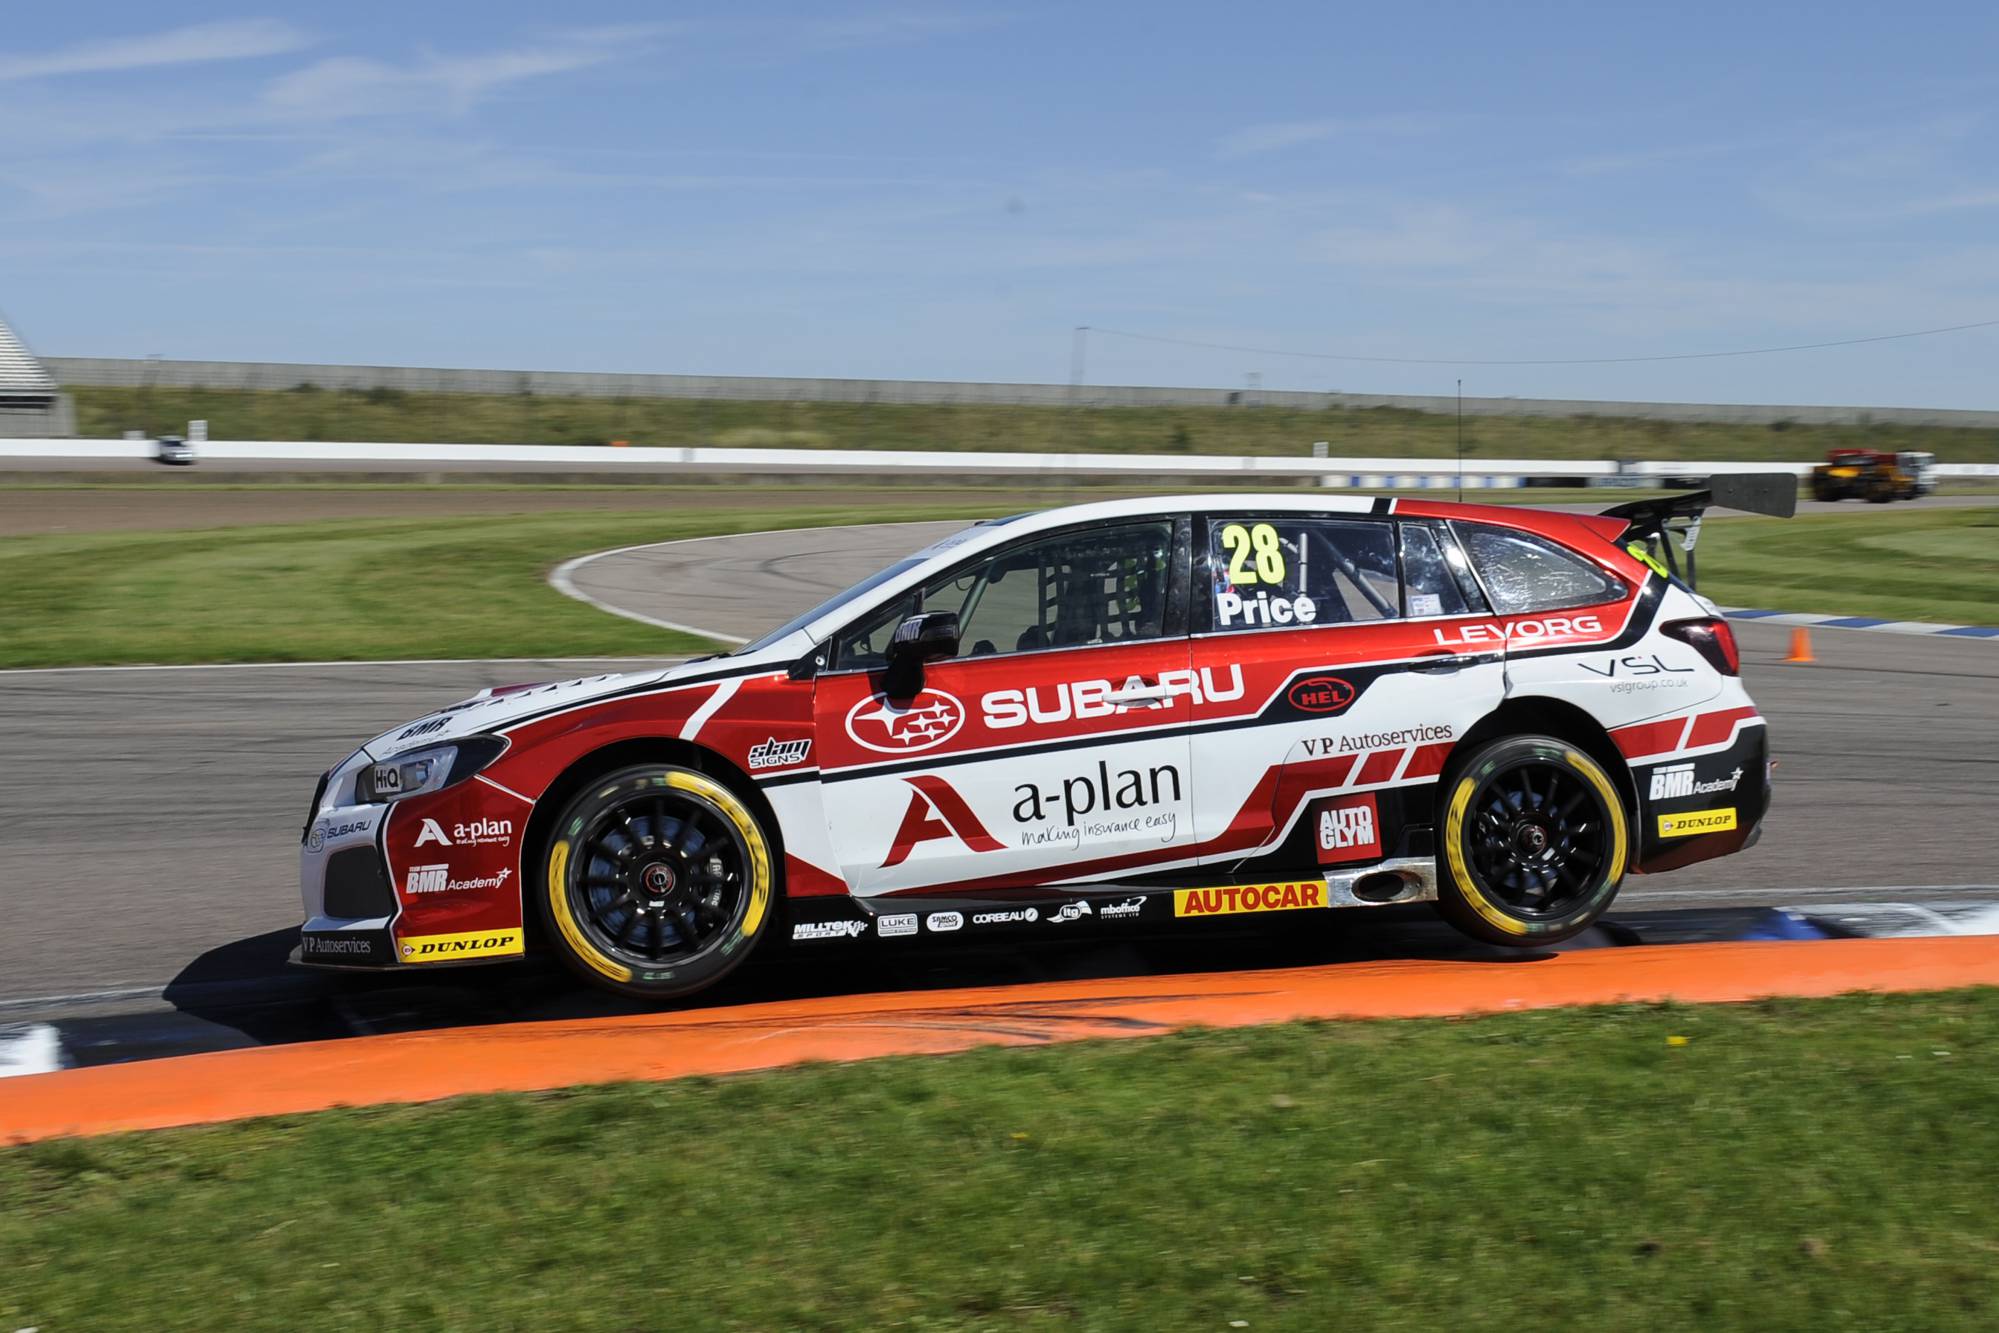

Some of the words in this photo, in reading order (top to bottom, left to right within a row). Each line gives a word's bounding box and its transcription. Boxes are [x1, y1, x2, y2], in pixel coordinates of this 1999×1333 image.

[1222, 523, 1285, 584] 28
[1216, 591, 1317, 626] Price
[1434, 615, 1602, 645] LEVORG
[1577, 655, 1694, 677] VSL
[981, 664, 1245, 729] SUBARU
[1301, 690, 1345, 706] HEL
[1339, 723, 1453, 752] Autoservices
[750, 754, 801, 767] SIGNS
[376, 768, 399, 789] HiQ
[1649, 770, 1695, 800] BMR
[1012, 760, 1181, 826] a-plan
[327, 820, 372, 839] SUBARU
[453, 817, 512, 840] a-plan
[1021, 825, 1080, 851] making
[1083, 816, 1142, 837] insurance
[1145, 811, 1176, 843] easy
[1320, 805, 1373, 833] AUTO
[1676, 815, 1732, 830] DUNLOP
[1320, 824, 1375, 850] GLYM
[406, 870, 448, 894] BMR
[446, 875, 504, 891] Academy
[1184, 883, 1319, 914] AUTOCAR
[881, 917, 914, 927] LUKE
[973, 911, 1024, 924] CORBEAU
[316, 937, 371, 953] Autoservices
[419, 936, 514, 954] DUNLOP
